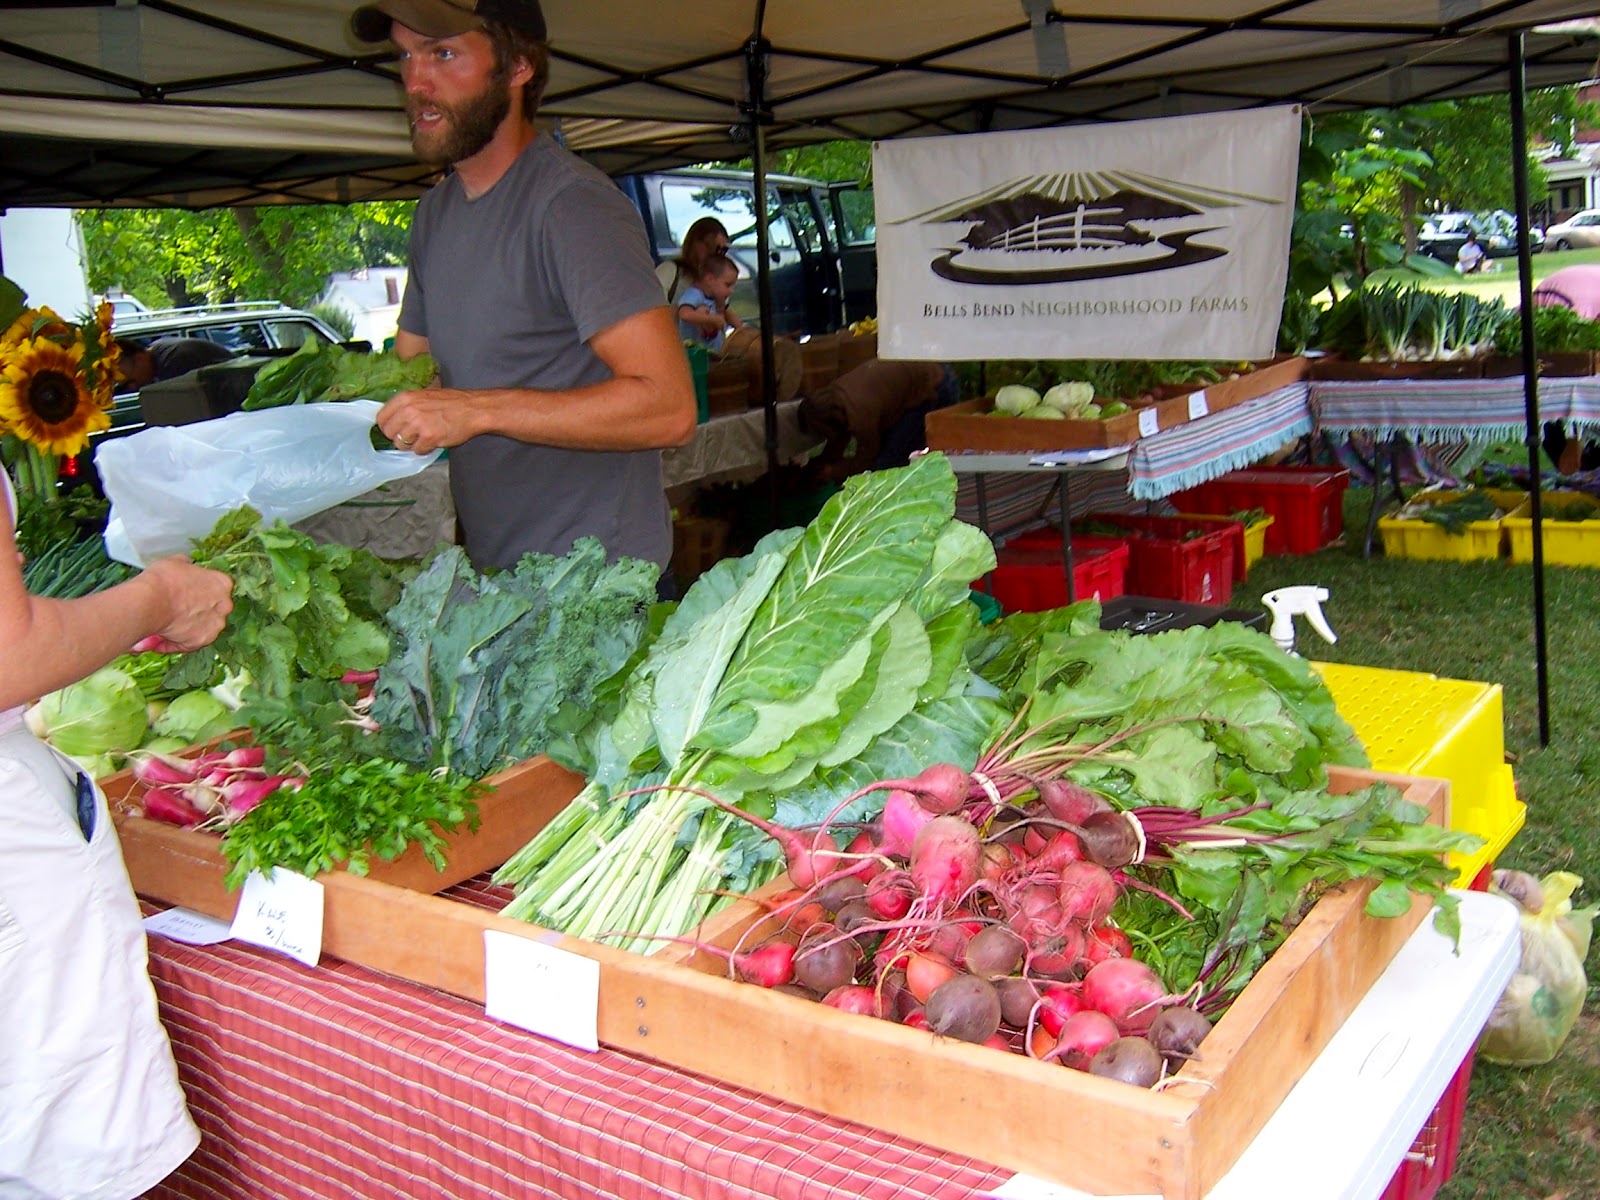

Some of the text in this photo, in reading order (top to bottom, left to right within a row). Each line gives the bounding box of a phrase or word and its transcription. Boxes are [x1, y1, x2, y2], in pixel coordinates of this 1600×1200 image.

[923, 295, 1248, 317] BELLS BEND NEIGHBORHOOD FARMS
